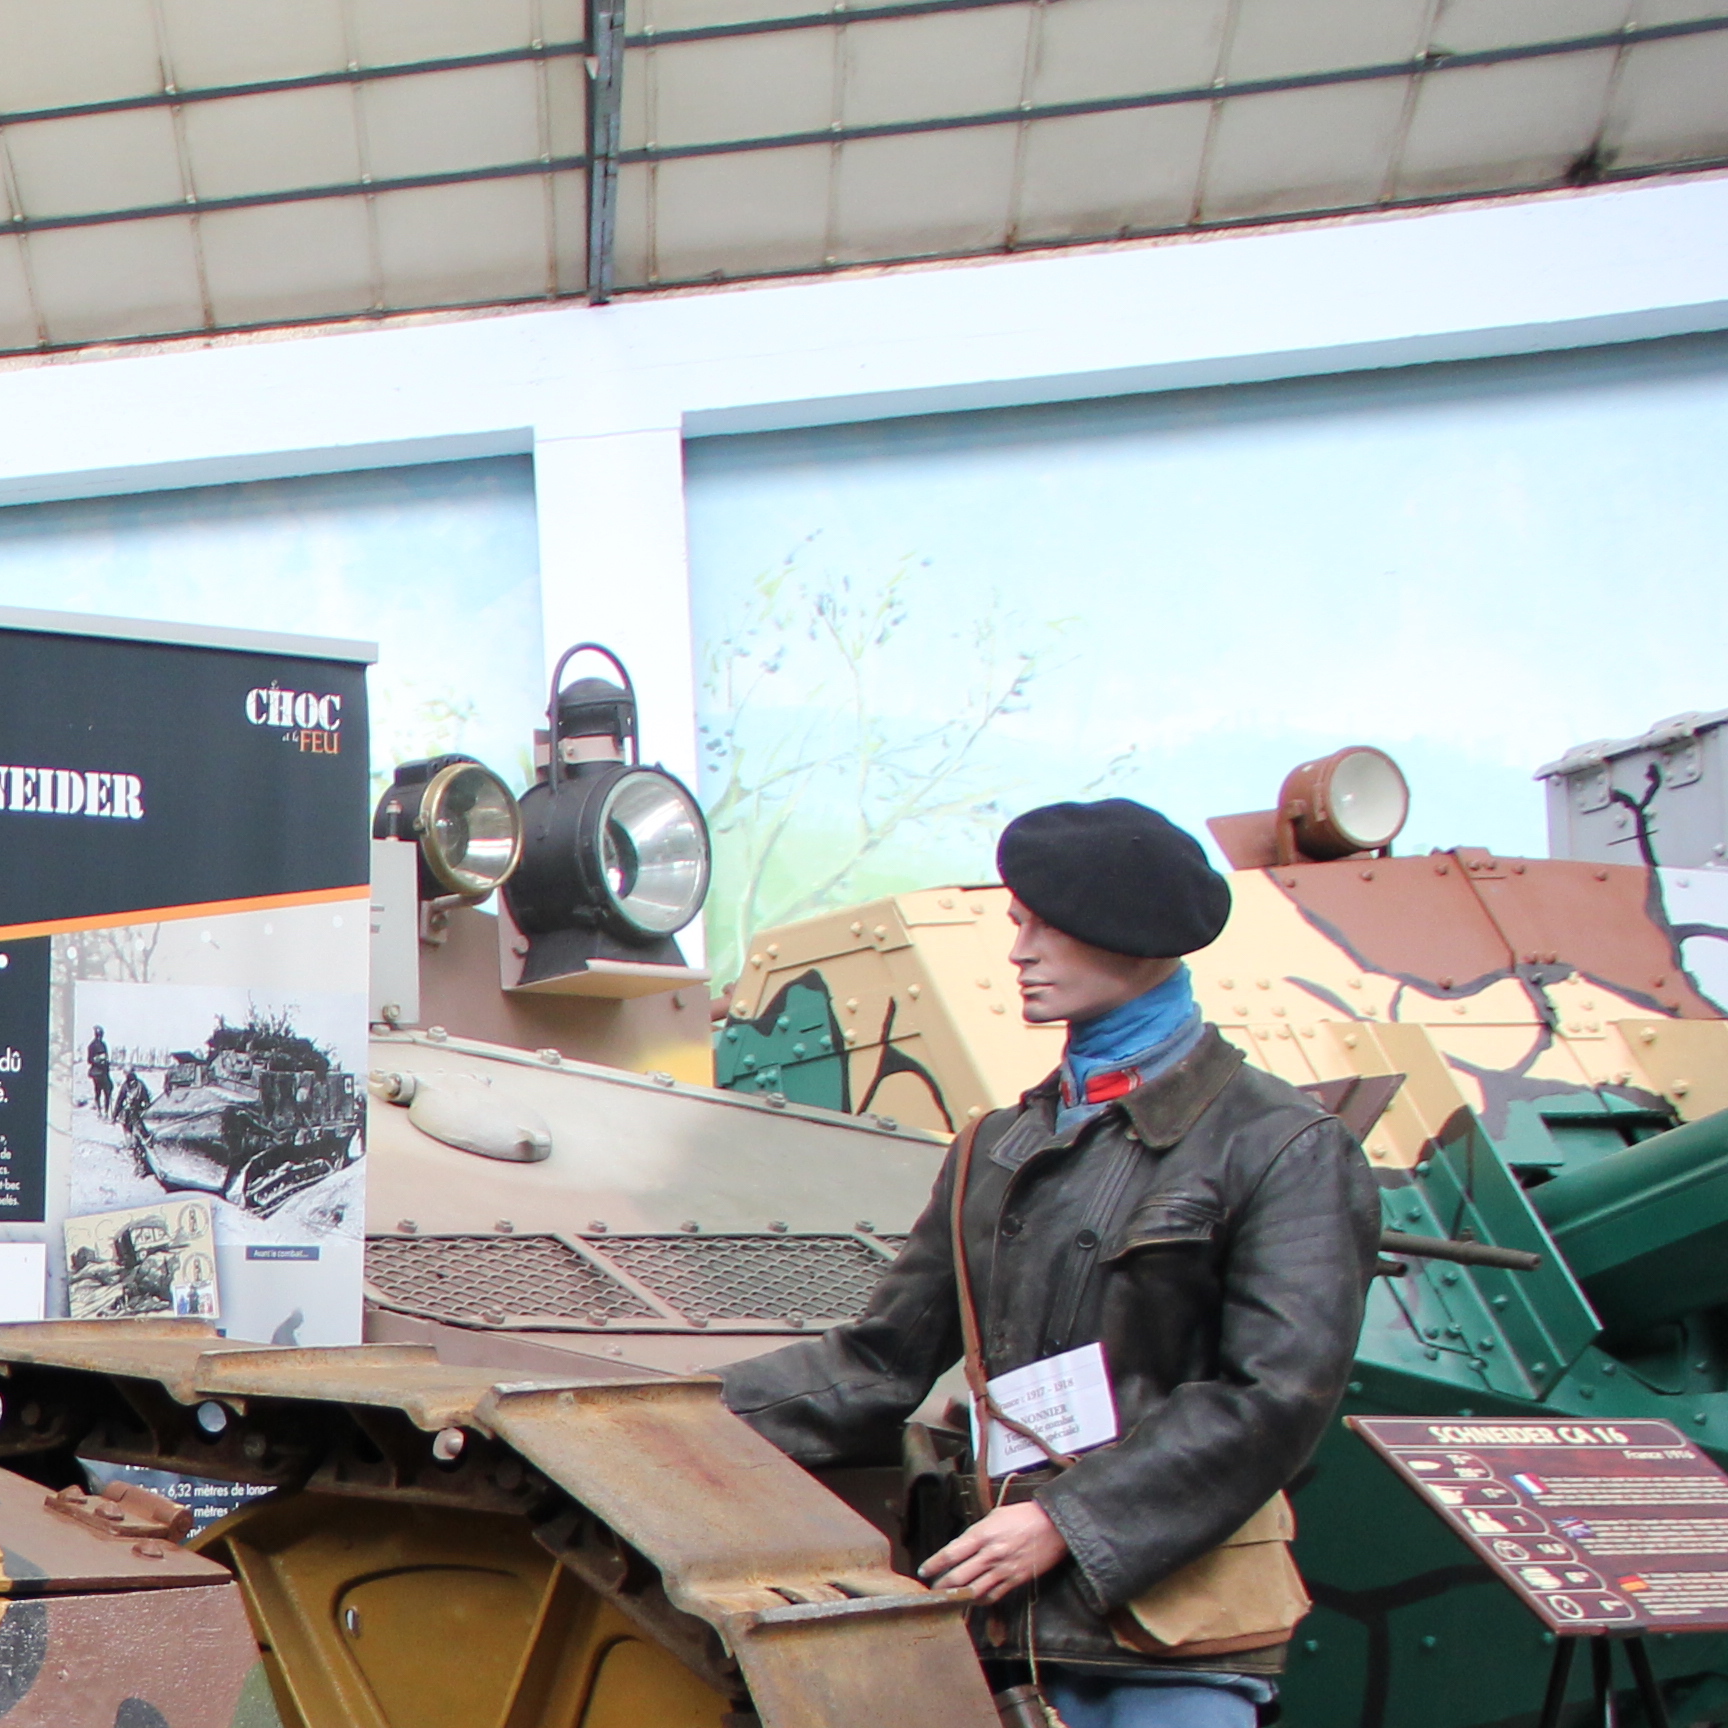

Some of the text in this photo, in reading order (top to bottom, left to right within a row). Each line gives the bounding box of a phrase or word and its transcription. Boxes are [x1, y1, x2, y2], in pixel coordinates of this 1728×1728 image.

[246, 688, 341, 731] CHOC
[300, 730, 340, 754] FEU
[0, 1047, 21, 1072] dû
[0, 1148, 11, 1159] de
[1428, 1426, 1629, 1444] SCHNEIDER CA 16
[168, 1484, 190, 1500] 6,32
[194, 1484, 228, 1496] mètres
[232, 1483, 244, 1496] de
[194, 1504, 228, 1518] mètres
